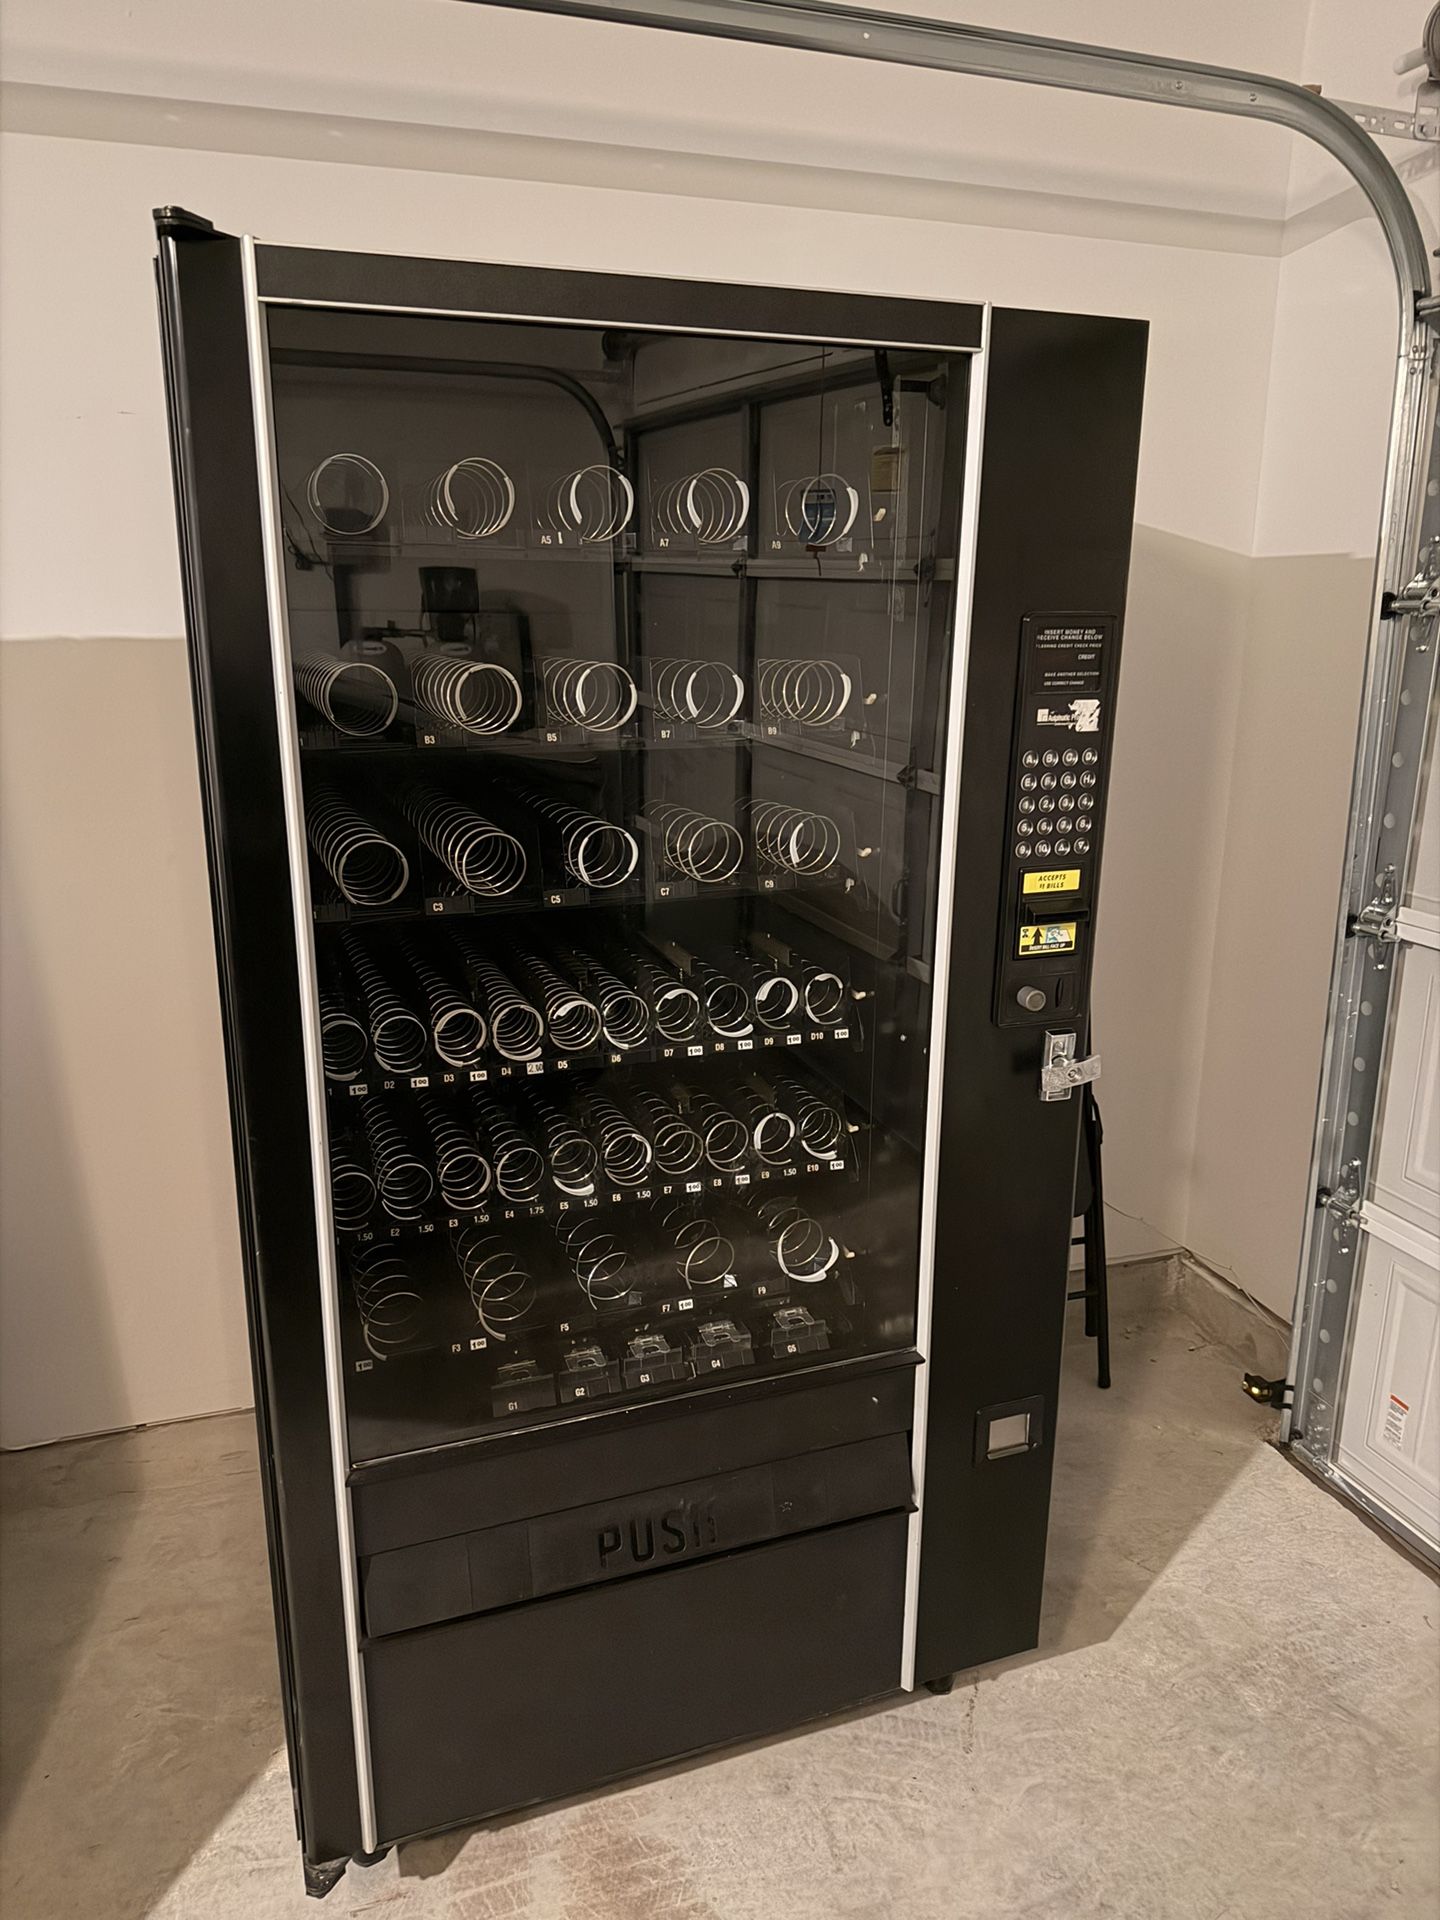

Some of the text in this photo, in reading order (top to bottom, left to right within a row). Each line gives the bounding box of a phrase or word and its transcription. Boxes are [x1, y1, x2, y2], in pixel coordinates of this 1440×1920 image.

[541, 535, 552, 545] A5
[659, 538, 669, 547] A7
[772, 541, 782, 550] A9
[661, 730, 671, 739] B7
[768, 726, 777, 736] B9
[424, 735, 435, 745] B3
[547, 733, 557, 742] B5
[1038, 873, 1067, 882] ACCEPTS
[764, 880, 774, 888] C9
[660, 887, 670, 896] C7
[551, 895, 561, 904] C5
[433, 903, 443, 912] C3
[810, 1032, 824, 1040] D10
[764, 1037, 774, 1045] D9
[715, 1043, 725, 1051] D8
[664, 1049, 674, 1057] D7
[611, 1054, 621, 1063] D6
[557, 1061, 568, 1069] D5
[501, 1067, 511, 1075] D4
[444, 1074, 454, 1082] D3
[384, 1081, 395, 1089] D2
[807, 1164, 819, 1172] E10
[761, 1168, 797, 1179] E9 1.50
[713, 1178, 722, 1187] E8
[663, 1186, 672, 1194] E7
[612, 1190, 651, 1202] E6 1.50
[560, 1198, 598, 1210] E5 1.50
[505, 1206, 545, 1219] E4 1.75
[449, 1214, 490, 1228] E3 1.50
[390, 1224, 434, 1237] E2 1.50
[357, 1232, 374, 1241] 1.50
[758, 1286, 767, 1295] F9
[662, 1304, 671, 1312] F7
[560, 1323, 570, 1332] F5
[452, 1343, 461, 1353] F3
[787, 1344, 797, 1353] G5
[711, 1359, 721, 1368] G4
[640, 1375, 650, 1384] G3
[575, 1387, 585, 1396] G2
[508, 1402, 518, 1411] G1
